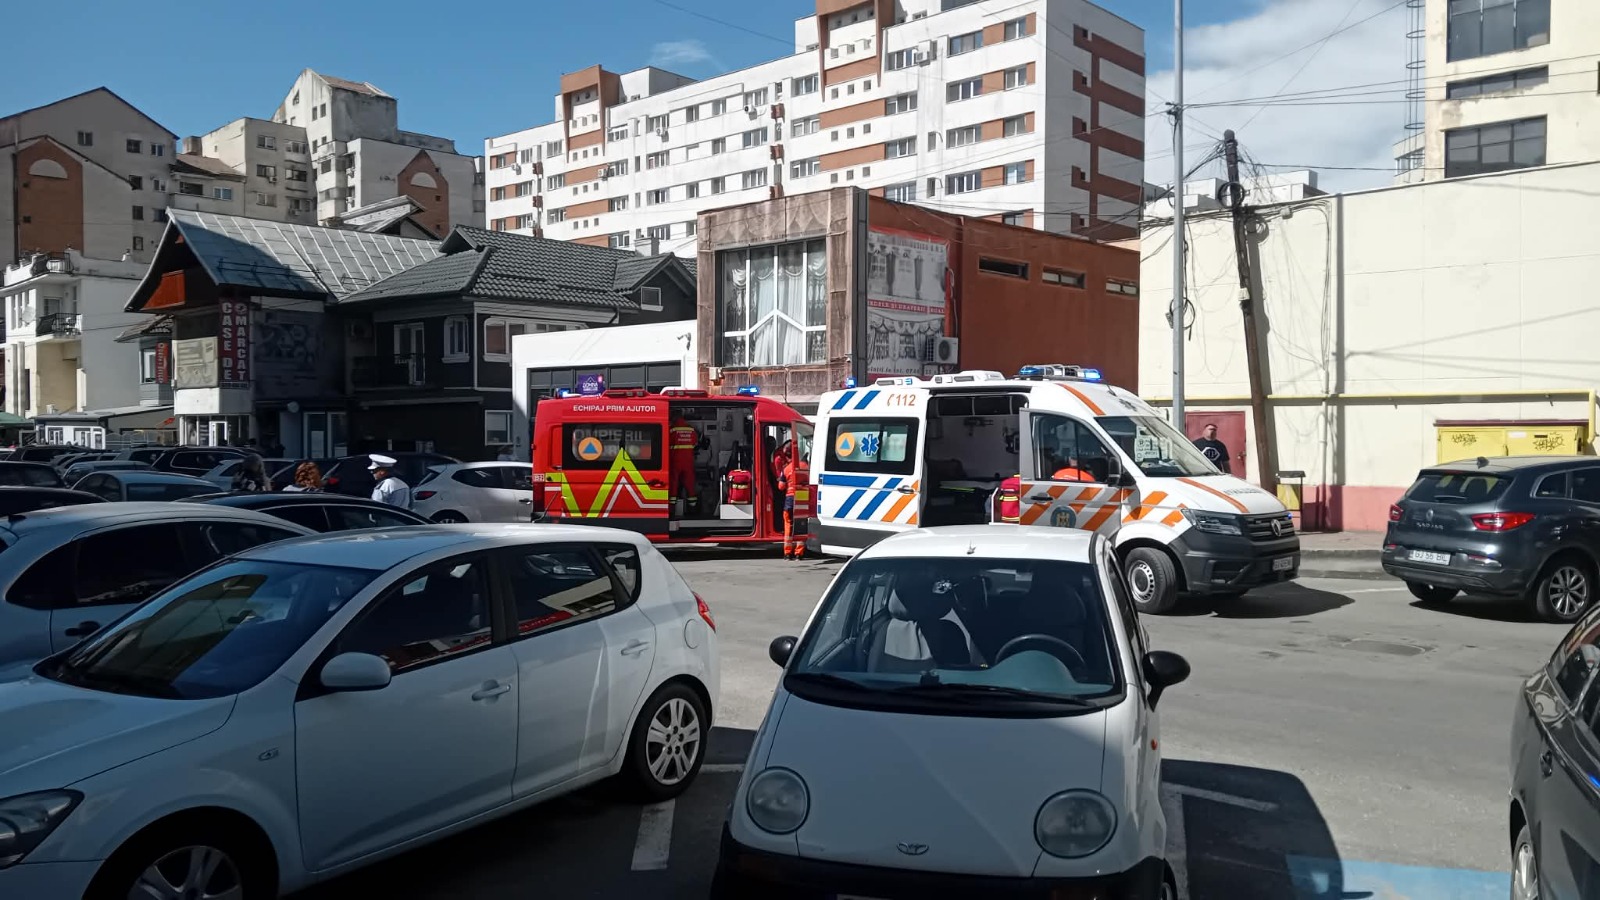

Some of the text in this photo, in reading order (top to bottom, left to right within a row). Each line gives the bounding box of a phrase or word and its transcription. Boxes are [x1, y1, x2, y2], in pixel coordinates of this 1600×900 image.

[222, 302, 233, 380] CASE DE
[896, 394, 916, 406] 112
[574, 428, 643, 441] OMPIERII
